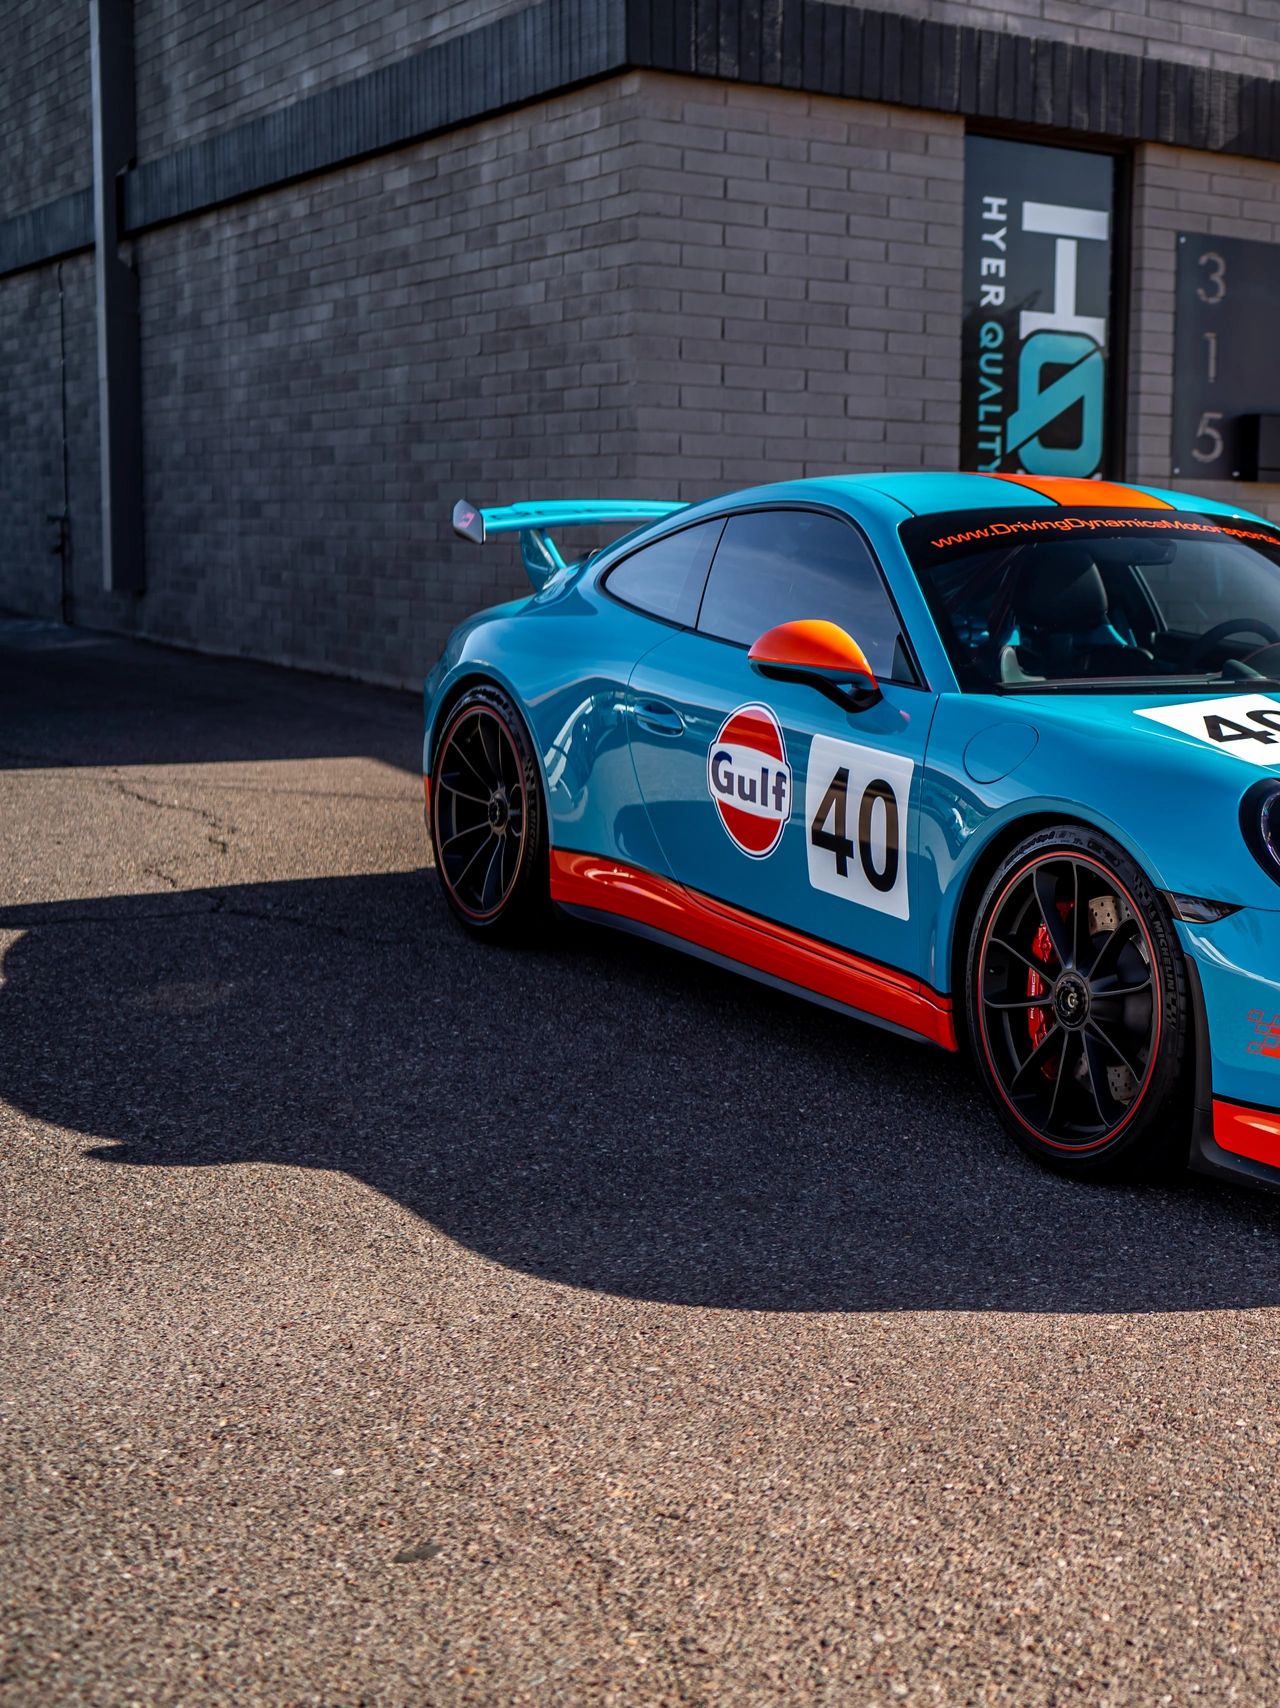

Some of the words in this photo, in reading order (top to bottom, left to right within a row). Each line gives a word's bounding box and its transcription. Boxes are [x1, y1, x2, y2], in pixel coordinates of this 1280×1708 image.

[979, 196, 1008, 307] HYER
[976, 320, 1005, 473] QUALITY
[1006, 201, 1109, 480] HQ
[711, 750, 787, 813] Gulf
[811, 766, 899, 893] 40
[1152, 919, 1176, 992] MICHELIN
